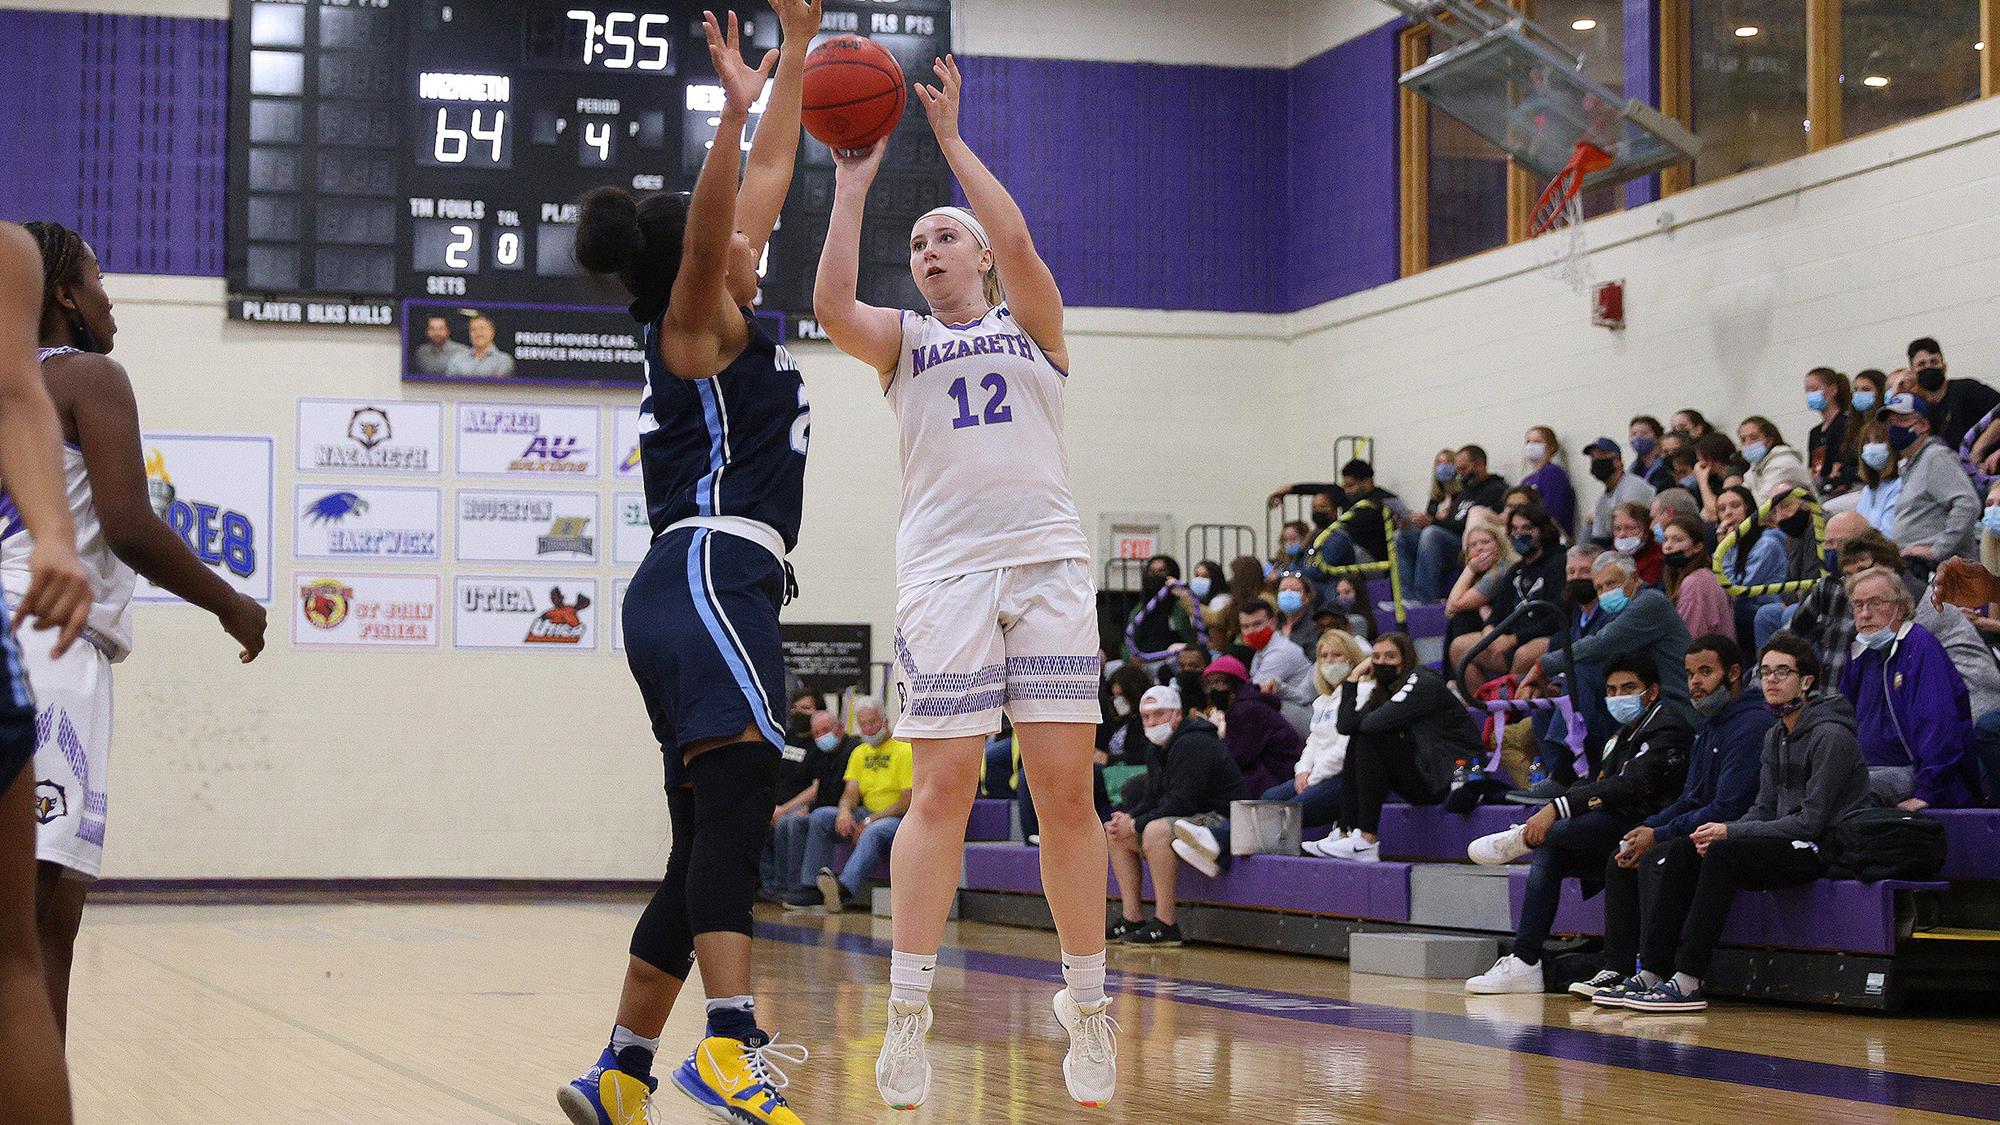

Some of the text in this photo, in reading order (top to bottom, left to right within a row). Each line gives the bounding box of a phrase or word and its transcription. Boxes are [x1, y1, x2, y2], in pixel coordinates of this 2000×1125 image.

[871, 13, 899, 34] FLS
[904, 14, 935, 35] PTS
[566, 9, 670, 71] 7:55
[576, 97, 621, 115] PERIOD
[434, 107, 505, 163] 64
[585, 122, 611, 161] 4
[409, 197, 486, 220] TM FOULS
[445, 225, 473, 269] 2
[497, 233, 519, 265] 0
[426, 275, 467, 295] SETS
[242, 301, 393, 325] PLAYER BLKS KILLS
[514, 331, 552, 346] PRICE
[553, 333, 599, 347] MOVES
[514, 345, 567, 361] SERVICE
[567, 347, 613, 362] MOVES
[912, 333, 1036, 378] NAZARETH
[947, 372, 1013, 430] 12
[521, 436, 577, 459] AU
[328, 529, 435, 555] HARTWICK
[465, 582, 536, 612] UTICA
[385, 603, 434, 620] JOHN
